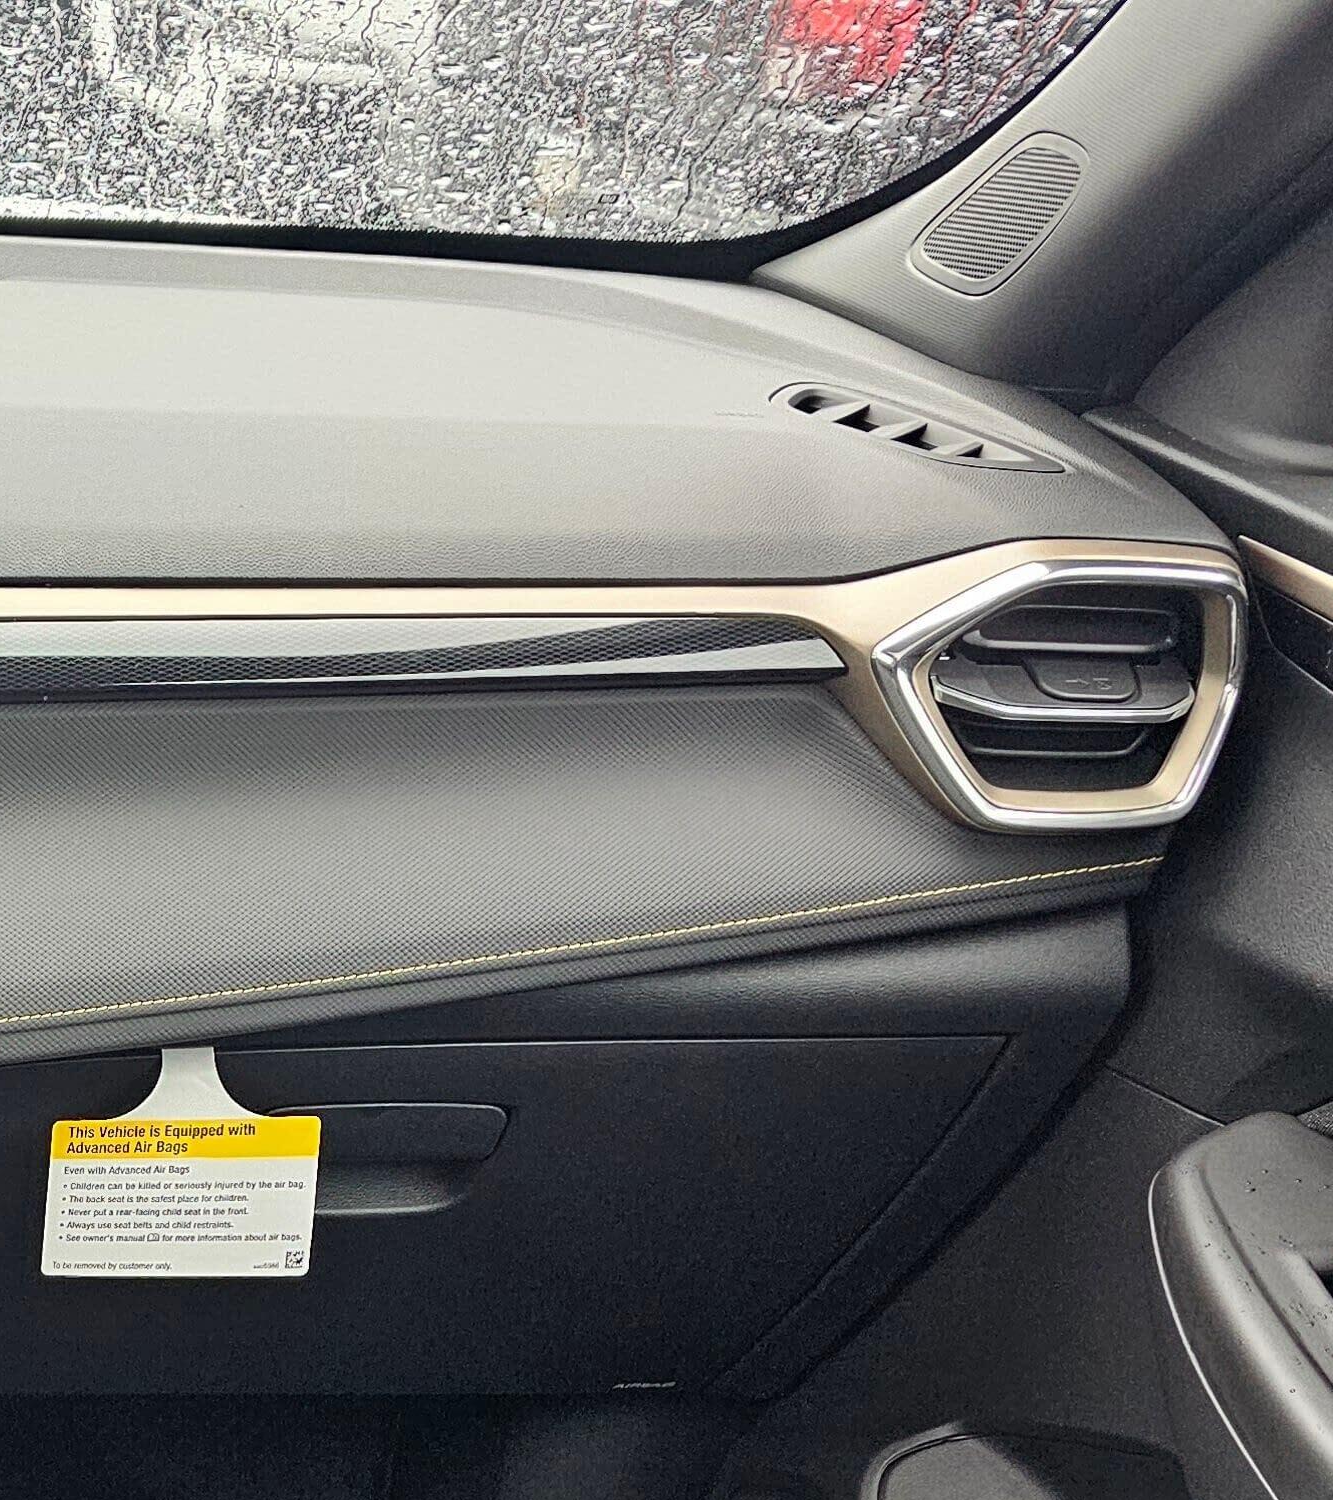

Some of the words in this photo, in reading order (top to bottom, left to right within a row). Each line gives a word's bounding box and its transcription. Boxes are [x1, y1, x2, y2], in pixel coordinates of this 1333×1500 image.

[68, 1126, 95, 1138] This
[99, 1126, 146, 1138] Vehicle
[150, 1125, 161, 1137] is
[164, 1124, 224, 1139] Equipped
[228, 1123, 256, 1136] with
[66, 1141, 130, 1154] Advanced
[134, 1141, 152, 1153] Air
[156, 1141, 189, 1155] Bags
[64, 1166, 85, 1175] Even
[87, 1166, 107, 1175] with
[108, 1166, 151, 1175] Advanced
[153, 1166, 166, 1174] Air
[168, 1166, 190, 1175] Bags
[70, 1182, 105, 1191] Children
[125, 1182, 136, 1190] be
[138, 1182, 161, 1190] killed
[174, 1181, 212, 1191] seriously
[214, 1180, 244, 1191] injured
[245, 1180, 257, 1190] by
[258, 1180, 273, 1189] the
[274, 1180, 286, 1188] air
[288, 1180, 307, 1190] bag.
[69, 1195, 84, 1203] The
[86, 1195, 105, 1203] back
[107, 1195, 125, 1203] seat
[127, 1195, 134, 1203] is
[136, 1195, 149, 1203] the
[151, 1195, 175, 1203] safest
[177, 1194, 199, 1204] place
[201, 1194, 212, 1203] for
[214, 1193, 250, 1202] children.
[68, 1208, 91, 1216] Never
[93, 1208, 107, 1217] put
[116, 1208, 160, 1217] rear-facing
[162, 1208, 182, 1216] child
[184, 1208, 201, 1216] seat
[203, 1207, 211, 1215] in
[213, 1207, 226, 1215] the
[227, 1207, 249, 1216] front.
[66, 1221, 95, 1230] Always
[97, 1221, 112, 1229] use
[114, 1221, 131, 1229] seat
[133, 1221, 153, 1229] belts
[154, 1221, 170, 1229] and
[172, 1221, 192, 1229] child
[193, 1220, 234, 1229] restraints.
[66, 1234, 81, 1242] See
[82, 1234, 114, 1242] owner's
[116, 1234, 145, 1242] manual
[162, 1234, 174, 1242] for
[175, 1234, 195, 1242] more
[197, 1233, 243, 1242] information
[244, 1233, 267, 1241] about
[268, 1233, 280, 1241] air
[281, 1232, 302, 1242] bags.
[53, 1261, 61, 1269] To
[62, 1261, 72, 1269] be
[74, 1261, 106, 1269] removed
[107, 1261, 117, 1270] by
[118, 1261, 153, 1270] customer
[155, 1261, 173, 1271] only.
